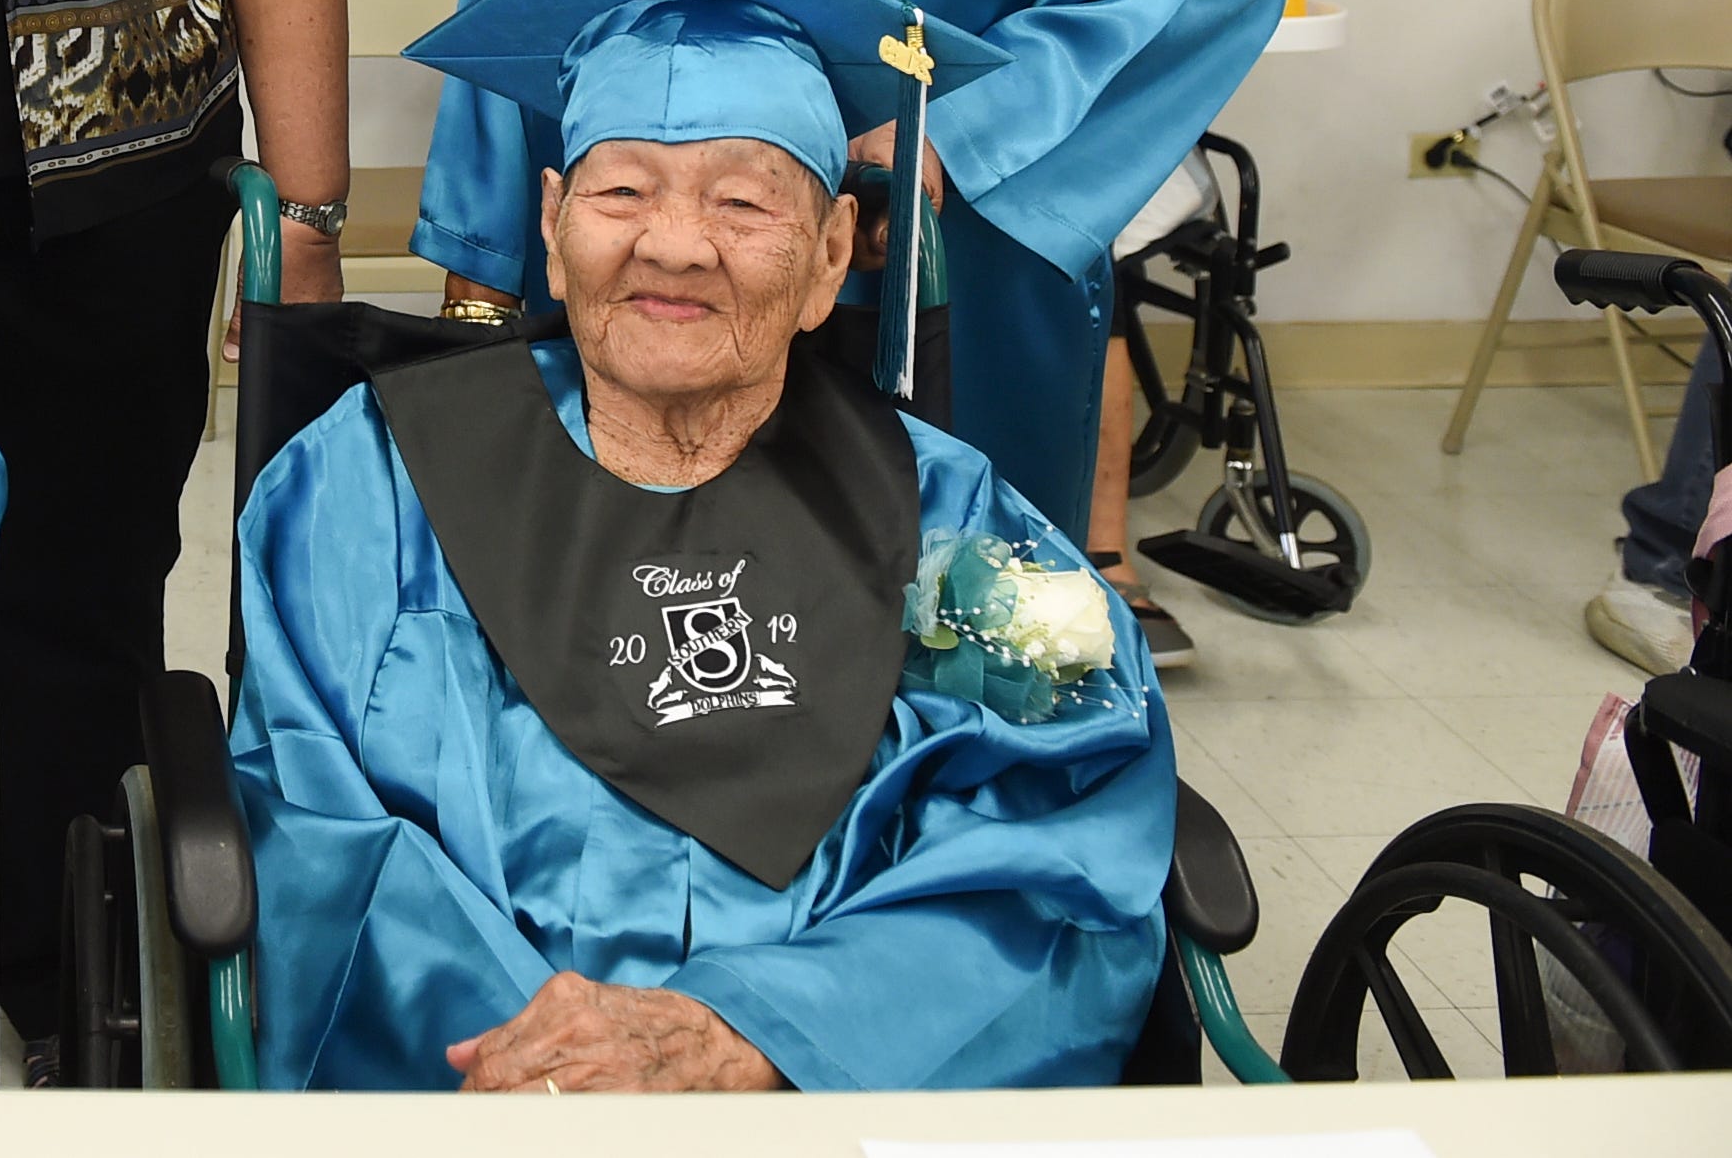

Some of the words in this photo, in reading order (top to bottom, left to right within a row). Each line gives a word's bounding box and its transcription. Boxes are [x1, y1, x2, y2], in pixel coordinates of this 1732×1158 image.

[632, 565, 713, 597] Class
[718, 559, 746, 598] of
[609, 634, 646, 667] 20
[767, 613, 797, 643] 19
[670, 612, 749, 667] SOUTHERN
[683, 606, 738, 681] S
[691, 691, 758, 712] DOLPHINS
